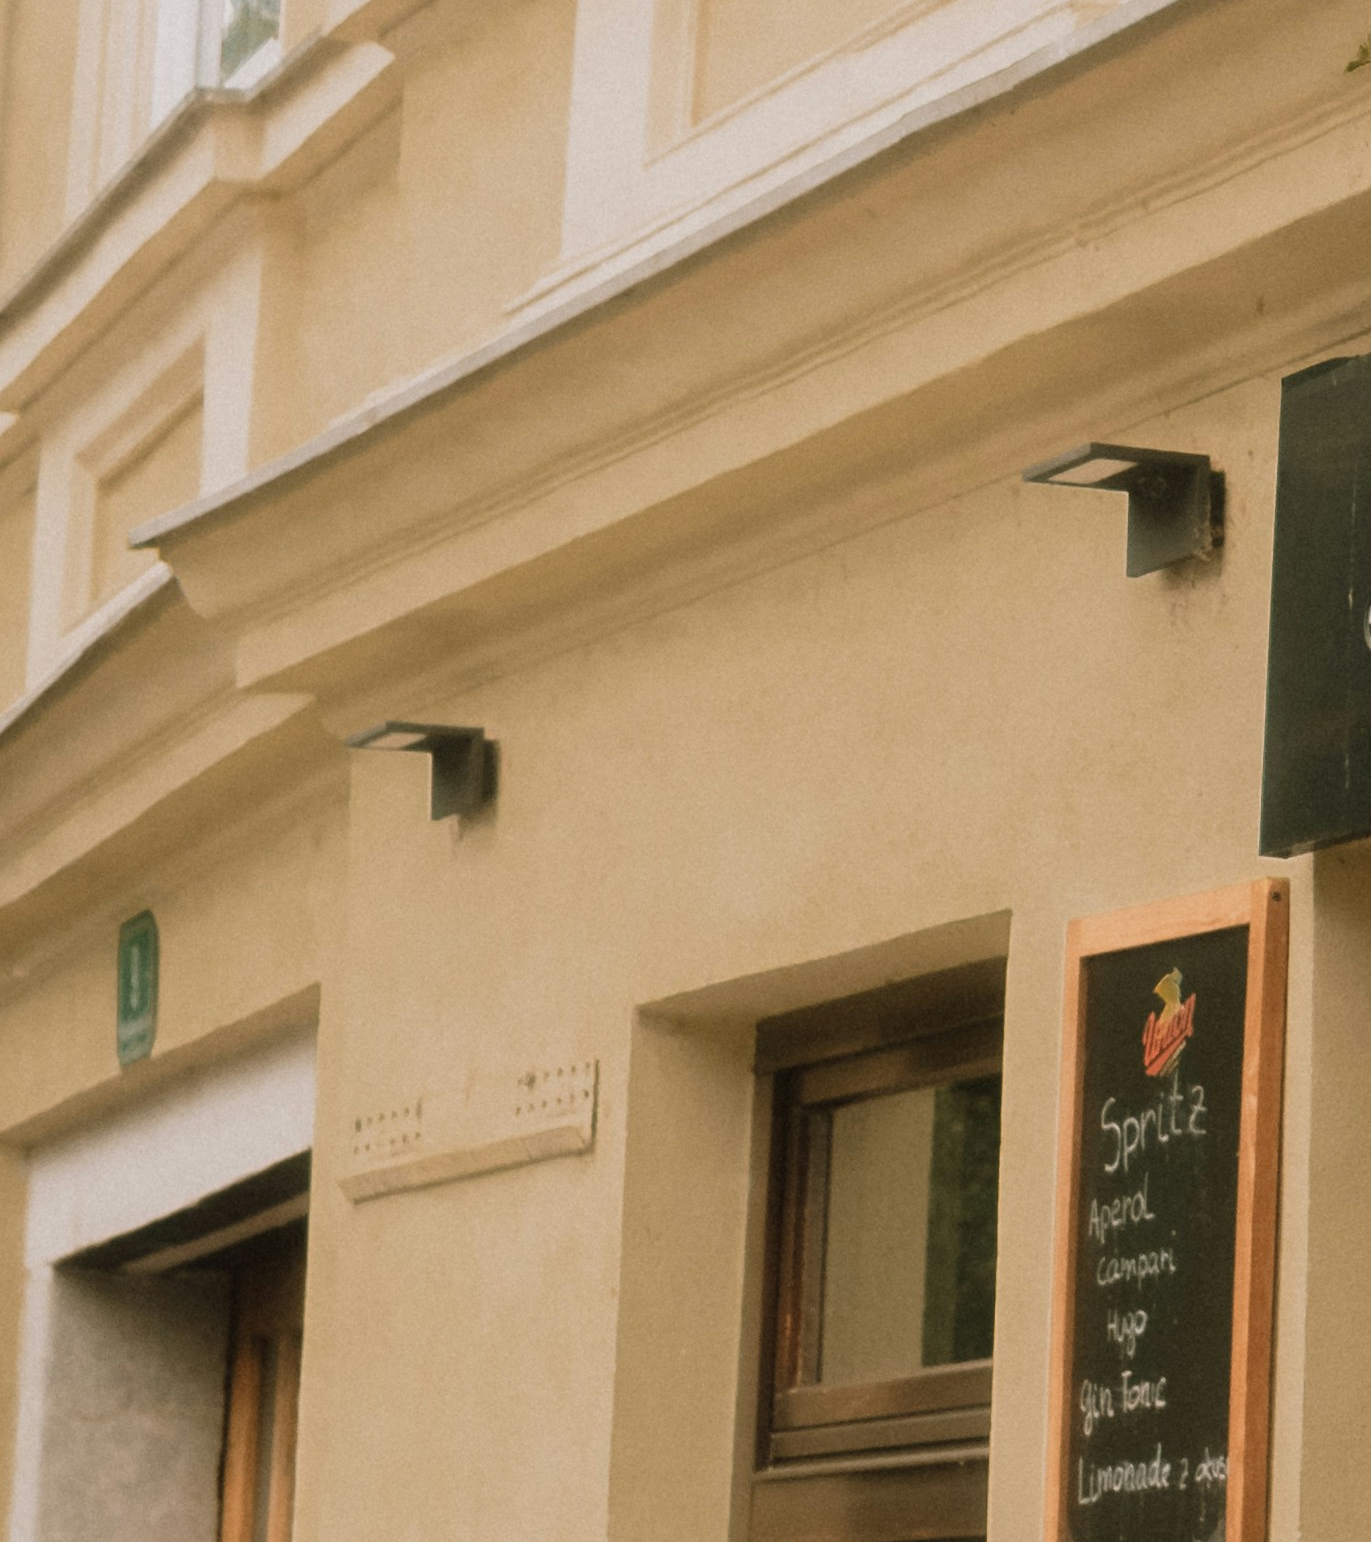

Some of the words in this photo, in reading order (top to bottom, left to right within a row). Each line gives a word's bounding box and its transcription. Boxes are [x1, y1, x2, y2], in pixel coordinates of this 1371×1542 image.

[1101, 1068, 1207, 1173] Spritz
[1088, 1171, 1156, 1244] Aperol
[1106, 1308, 1149, 1358] Hugo
